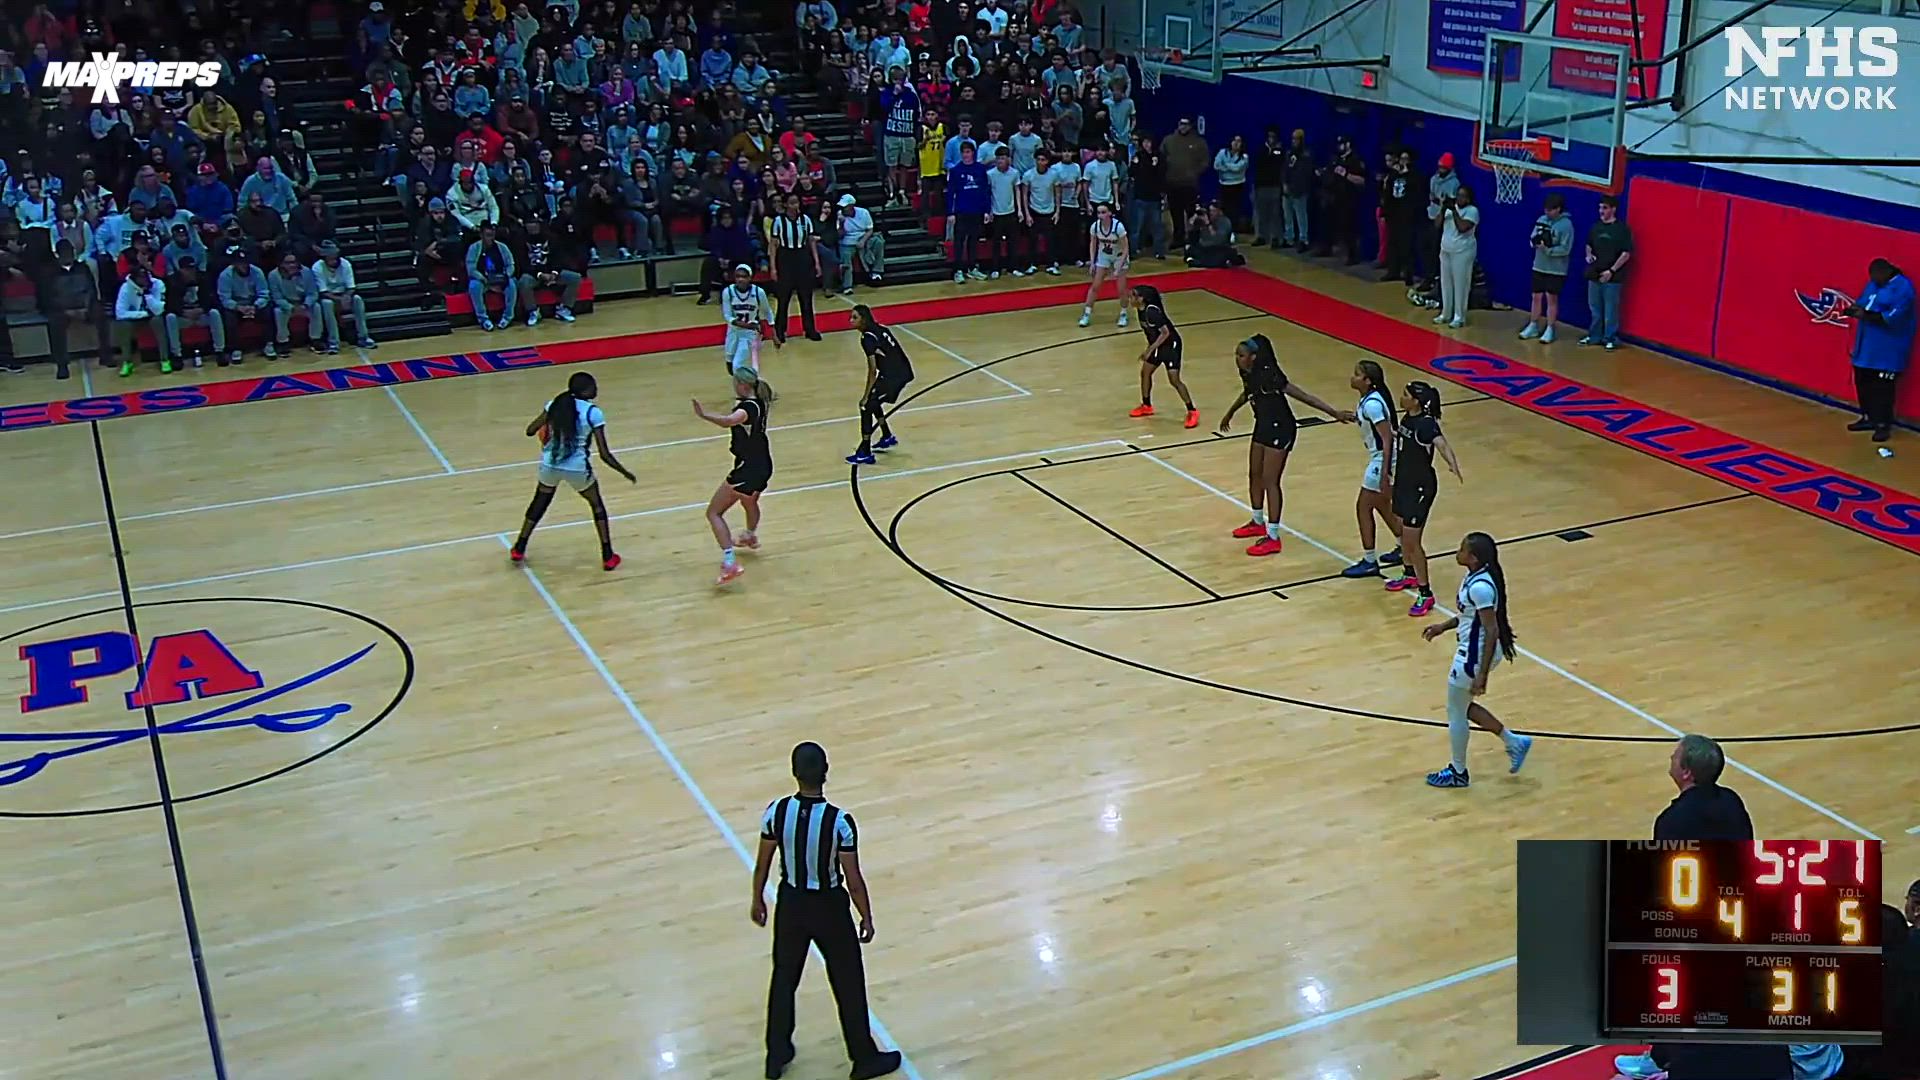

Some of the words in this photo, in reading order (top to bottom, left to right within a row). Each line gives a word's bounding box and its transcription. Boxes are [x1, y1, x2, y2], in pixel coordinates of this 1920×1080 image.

[882, 331, 896, 347] 2
[245, 346, 541, 401] ANNE
[1429, 354, 1920, 536] CAVALIERS
[19, 629, 265, 713] PA
[1671, 857, 1699, 906] 0
[1641, 910, 1674, 921] POSS
[1719, 900, 1742, 938] 4
[1794, 892, 1802, 931] 1
[1840, 900, 1861, 942] 5
[1654, 927, 1698, 938] BONUS
[1771, 932, 1812, 943] PERIOD
[1641, 954, 1681, 965] FOULS
[1746, 955, 1792, 967] PLAYER
[1809, 957, 1840, 968] FOUL
[1657, 968, 1678, 1010] 3
[1772, 970, 1793, 1012] 3
[1826, 971, 1836, 1013] 1
[1640, 1012, 1681, 1024] SCORE
[1768, 1015, 1812, 1026] MATCH
